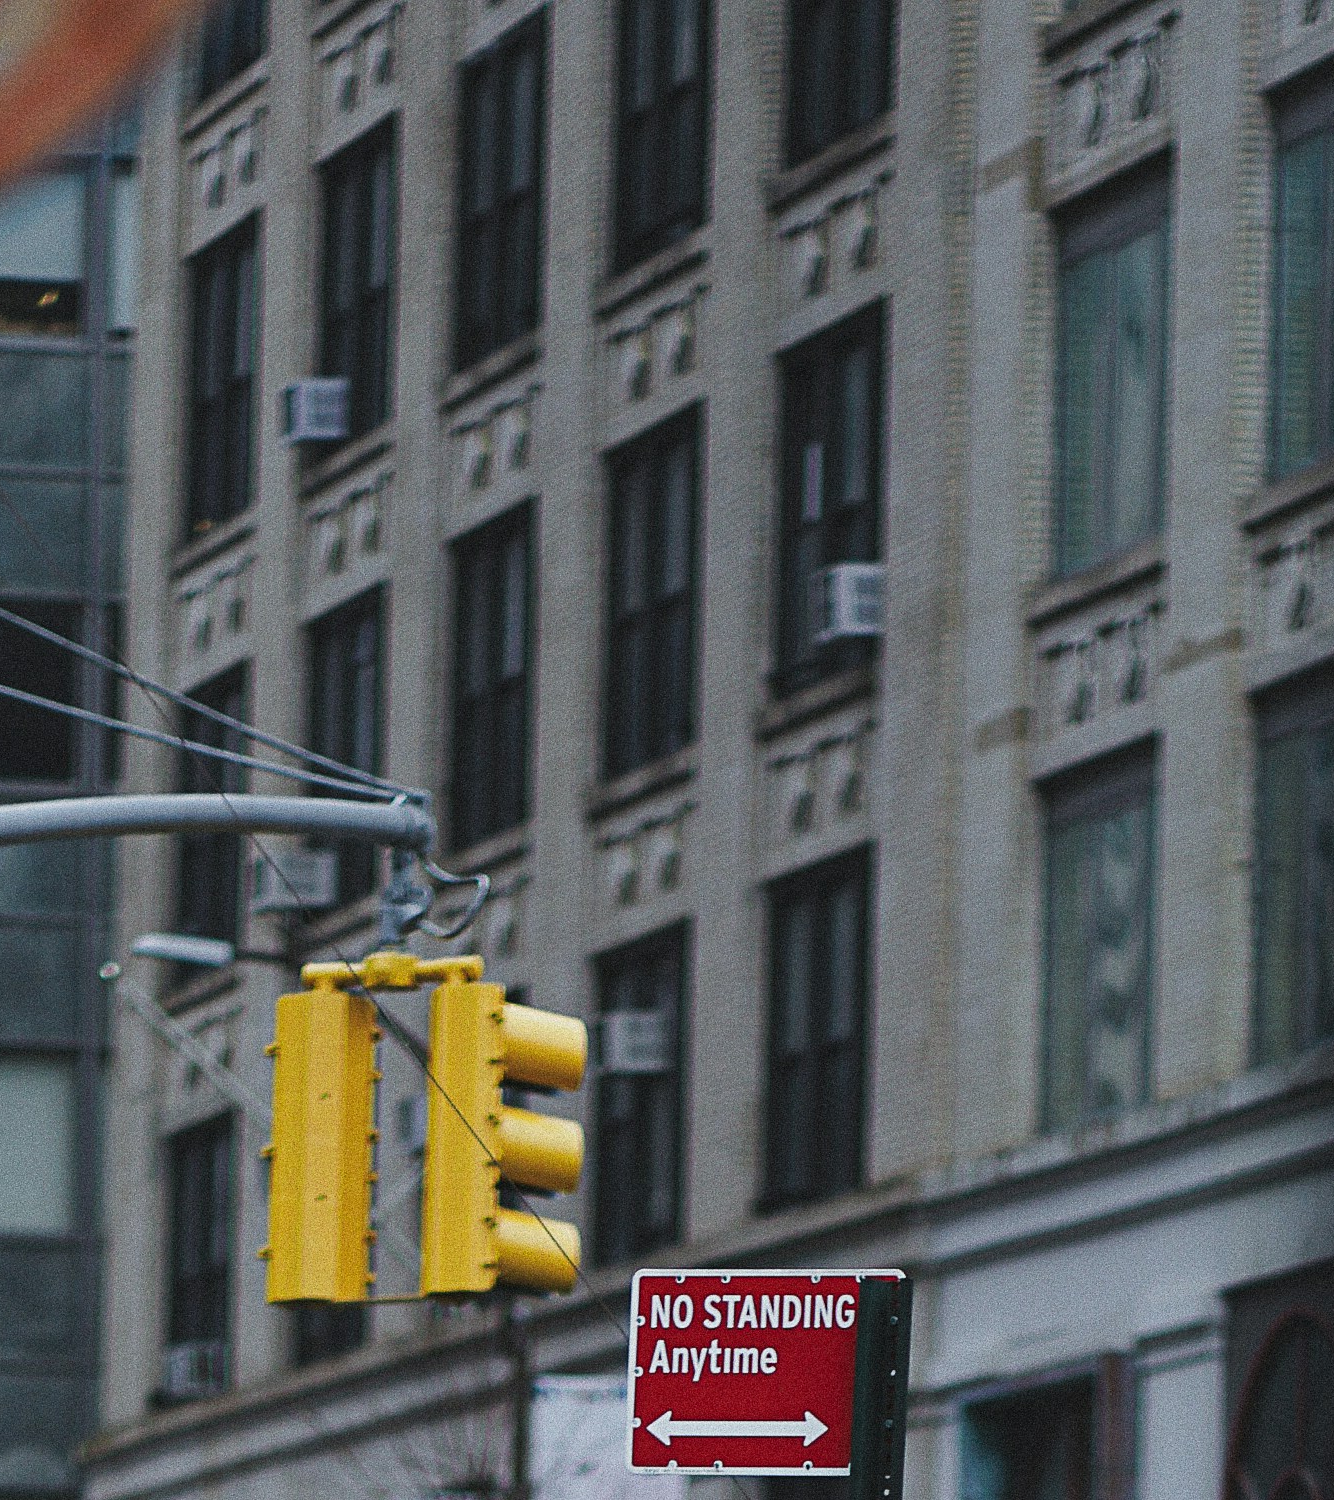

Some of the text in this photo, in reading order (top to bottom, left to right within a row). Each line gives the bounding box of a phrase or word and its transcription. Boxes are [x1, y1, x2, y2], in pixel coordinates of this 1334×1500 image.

[649, 1294, 856, 1330] NO STANDING
[648, 1339, 779, 1382] Anytime
